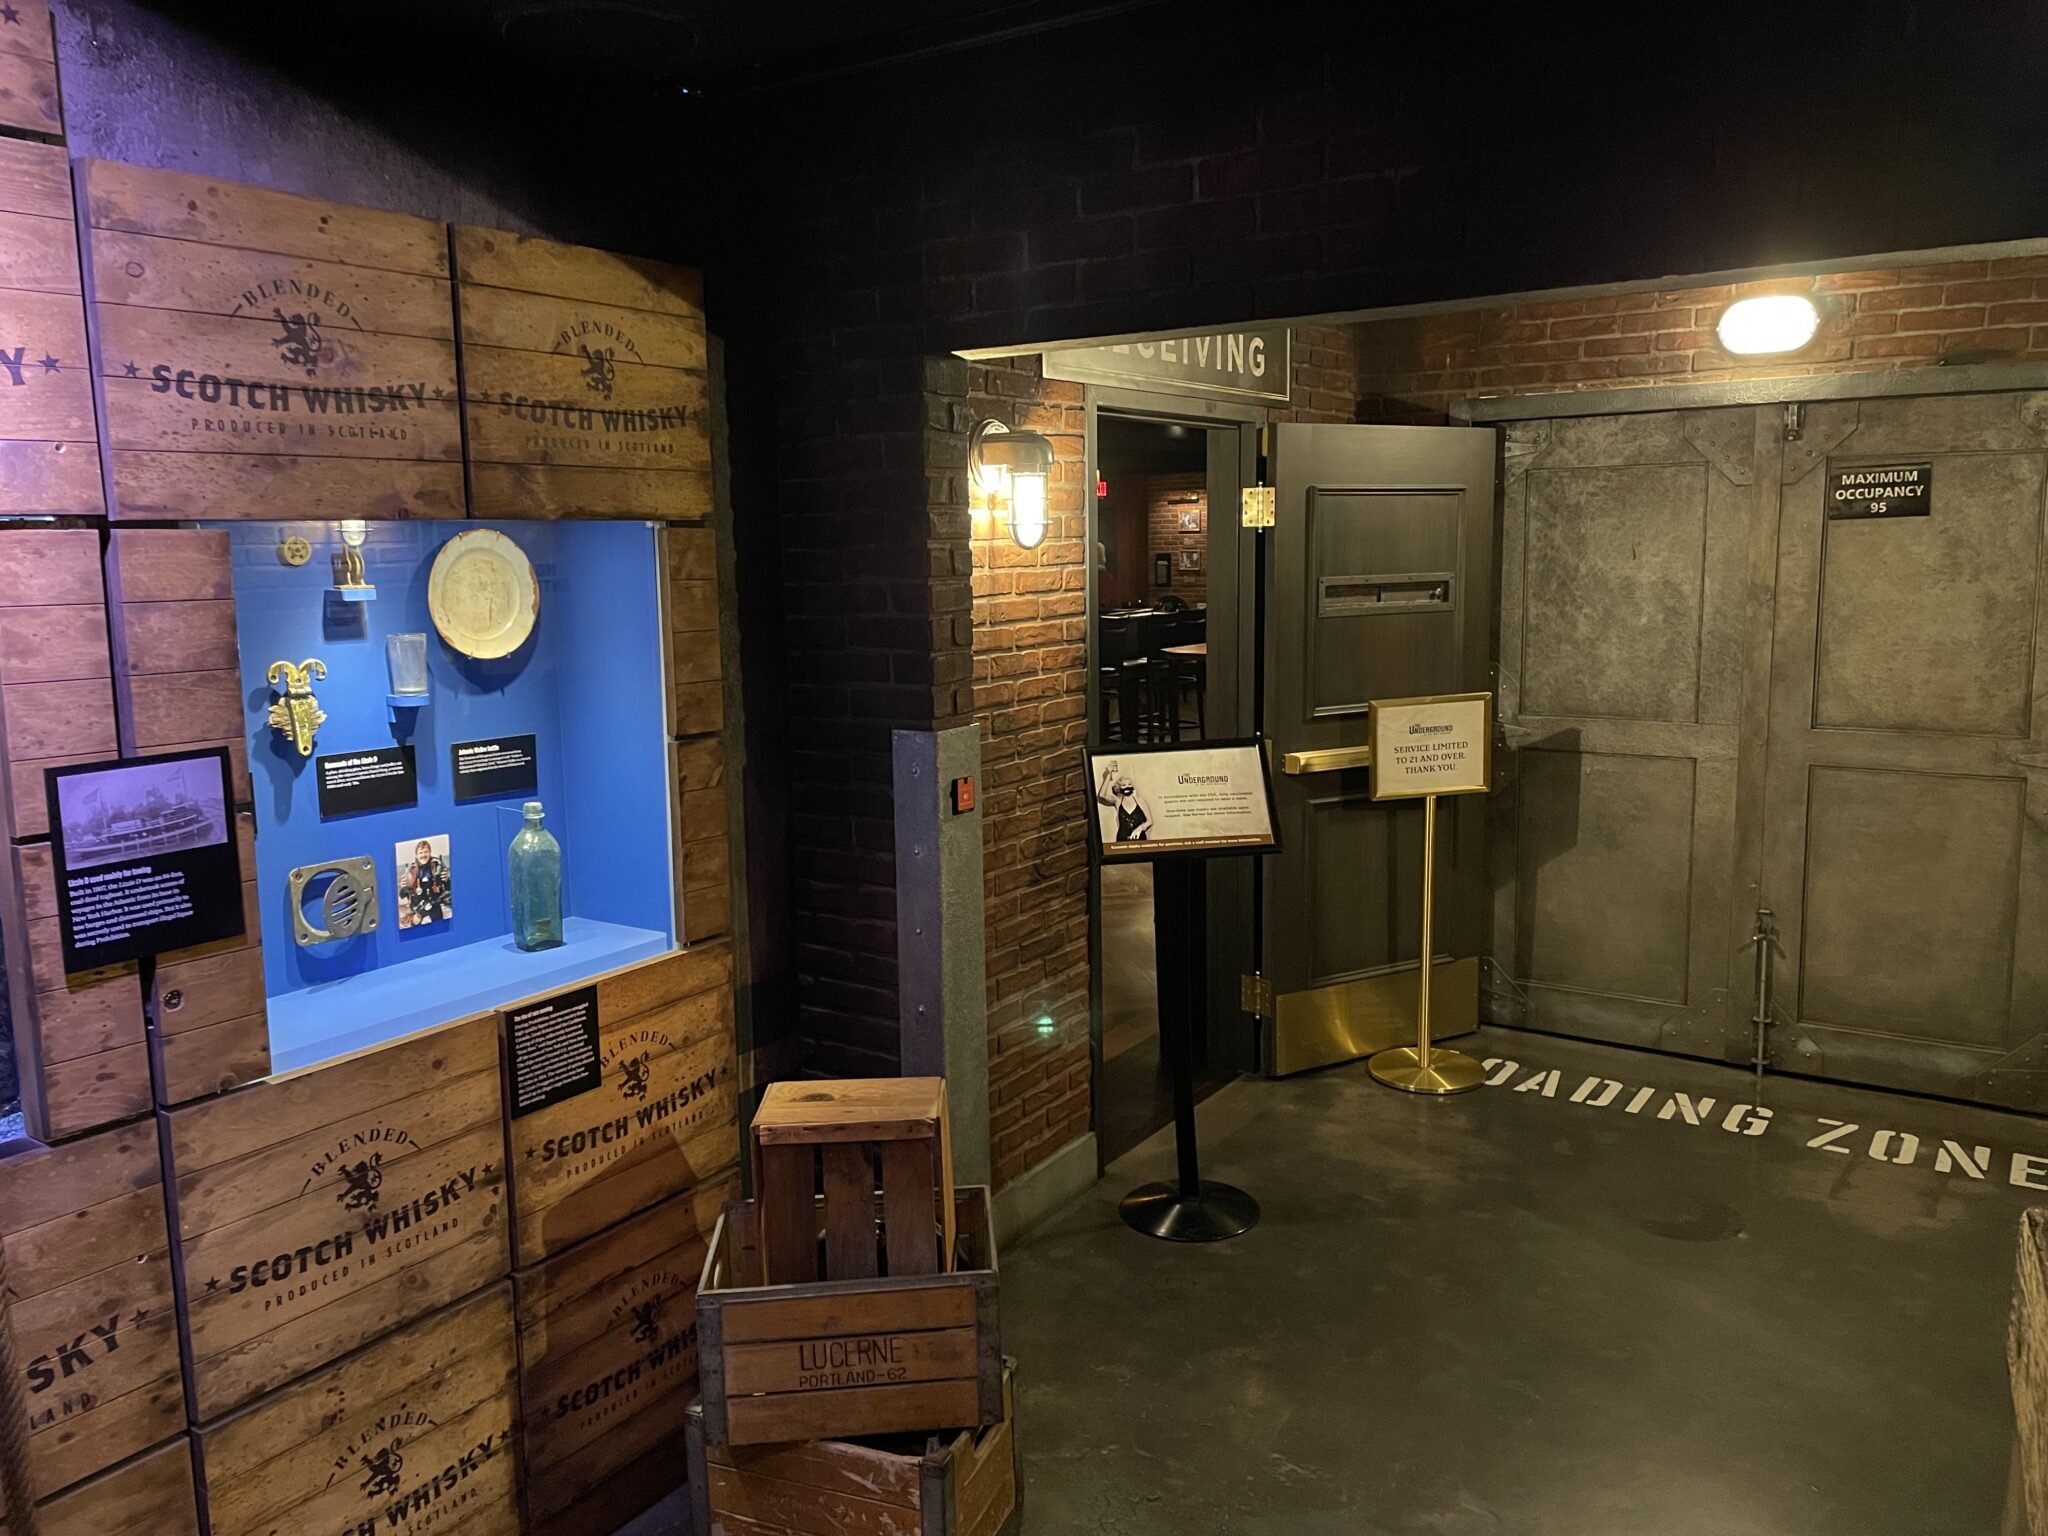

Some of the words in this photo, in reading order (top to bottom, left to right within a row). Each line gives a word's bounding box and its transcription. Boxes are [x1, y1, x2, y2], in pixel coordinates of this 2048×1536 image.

[242, 278, 350, 318] BLENDED
[561, 319, 635, 352] BLENDED
[151, 364, 290, 412] SCOTCH
[303, 382, 428, 414] WHISKY
[191, 417, 287, 435] PRODUCED
[300, 424, 315, 436] IN
[328, 425, 407, 441] SCOTLAND
[500, 391, 593, 431] SCOTCH
[602, 404, 688, 433] WHISKY
[1835, 485, 1924, 500] OCCUPANCY
[1841, 470, 1918, 485] MAXIMUM
[1870, 502, 1887, 513] 95
[1394, 744, 1430, 754] SERVICE
[1432, 741, 1468, 751] LIMITED
[1409, 725, 1453, 734] UNDERGROUND
[1396, 756, 1407, 764] TO
[1420, 753, 1439, 762] AND
[1405, 765, 1436, 774] THANK
[1177, 774, 1229, 785] UNDERGROUND
[600, 1030, 669, 1069] BLENDED
[542, 1116, 629, 1163] SCOTCH
[636, 1067, 717, 1129] WHISKY
[1482, 1058, 1774, 1136] OADING
[1806, 1117, 2048, 1191] ZONE
[311, 1127, 408, 1177] BLENDED
[566, 1145, 626, 1178] PRODUCED
[652, 1111, 703, 1141] SCOTLAND
[229, 1230, 354, 1294] SCOTCH
[363, 1166, 478, 1245] WHISKY
[264, 1265, 350, 1311] PRODUCED
[360, 1254, 376, 1269] IN
[386, 1217, 459, 1258] SCOTLAND
[612, 1271, 680, 1318] BLENDED
[800, 1336, 903, 1371] LUCERNE
[556, 1359, 642, 1419] SCOTCH
[799, 1366, 908, 1388] PORTLAND-62
[334, 1411, 428, 1470] BLENDED
[385, 1433, 495, 1528] WHISKY
